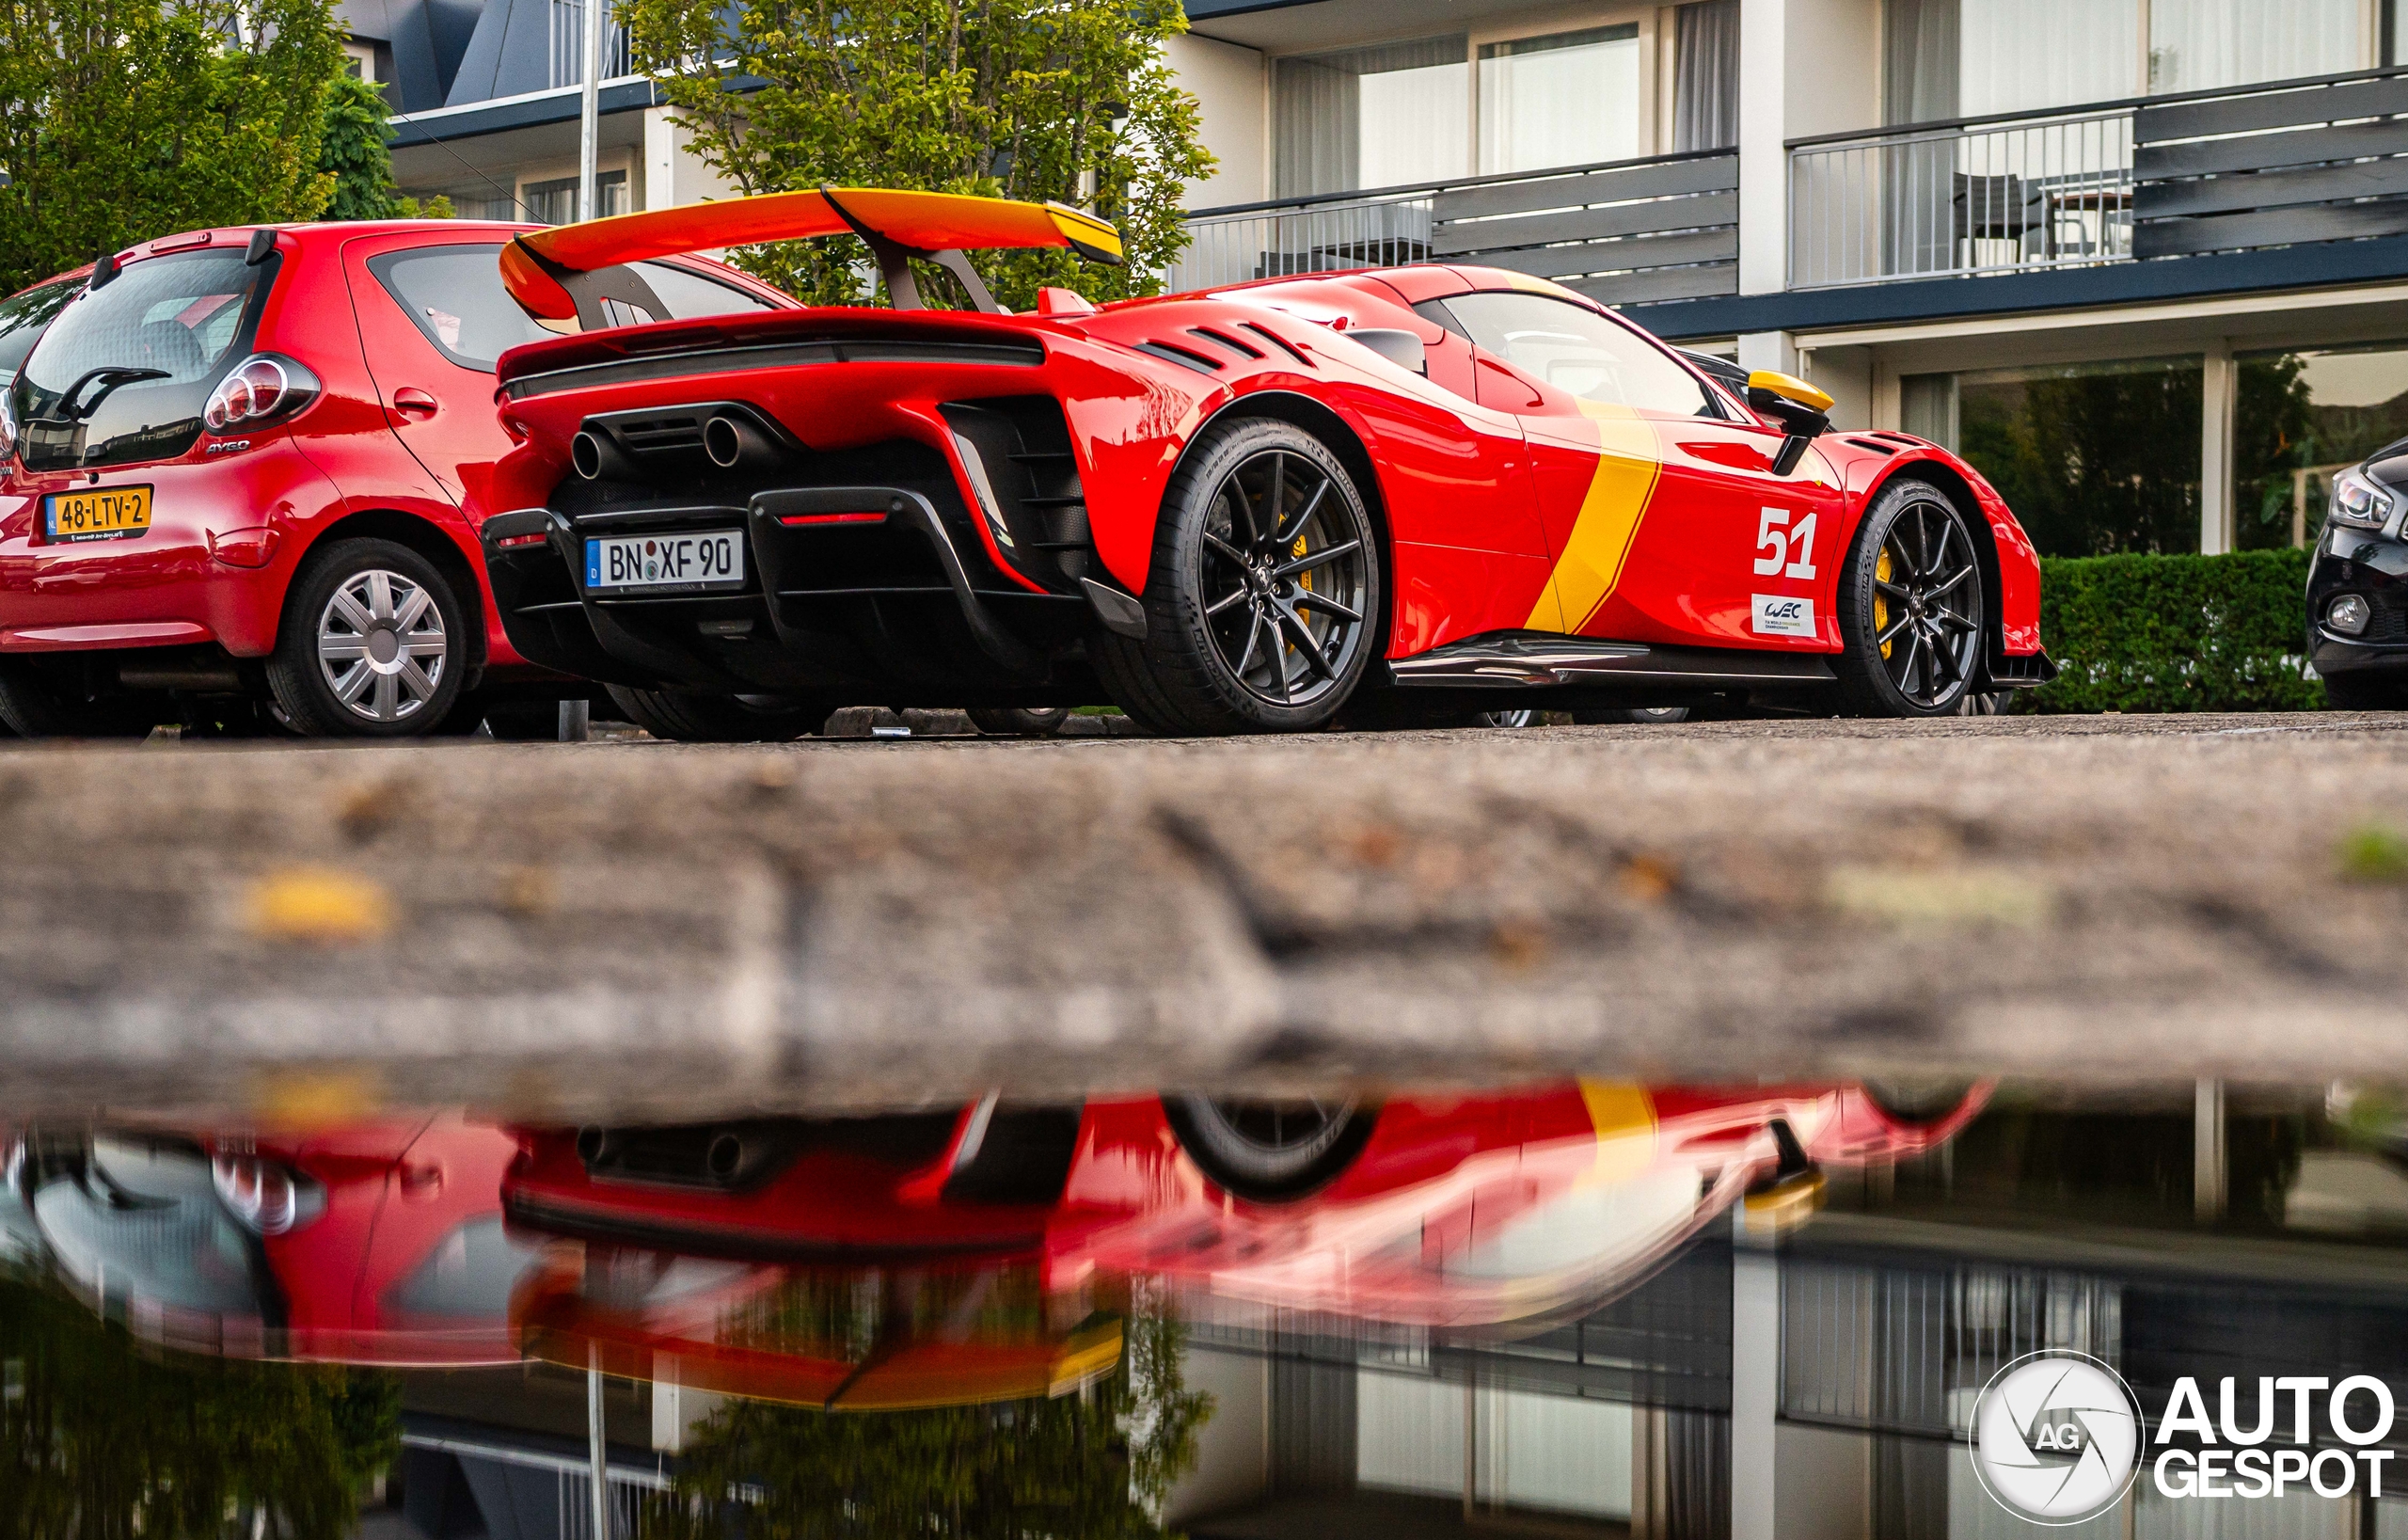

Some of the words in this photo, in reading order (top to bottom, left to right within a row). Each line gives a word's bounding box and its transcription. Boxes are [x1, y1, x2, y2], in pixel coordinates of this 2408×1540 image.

[206, 440, 250, 453] AYGO
[62, 494, 143, 529] 48-LTV-2
[48, 520, 56, 530] NL
[1753, 506, 1817, 580] 51
[610, 544, 642, 580] BN
[660, 540, 693, 578] XF
[699, 538, 731, 575] 90
[591, 568, 597, 579] D
[1765, 602, 1801, 619] WEC
